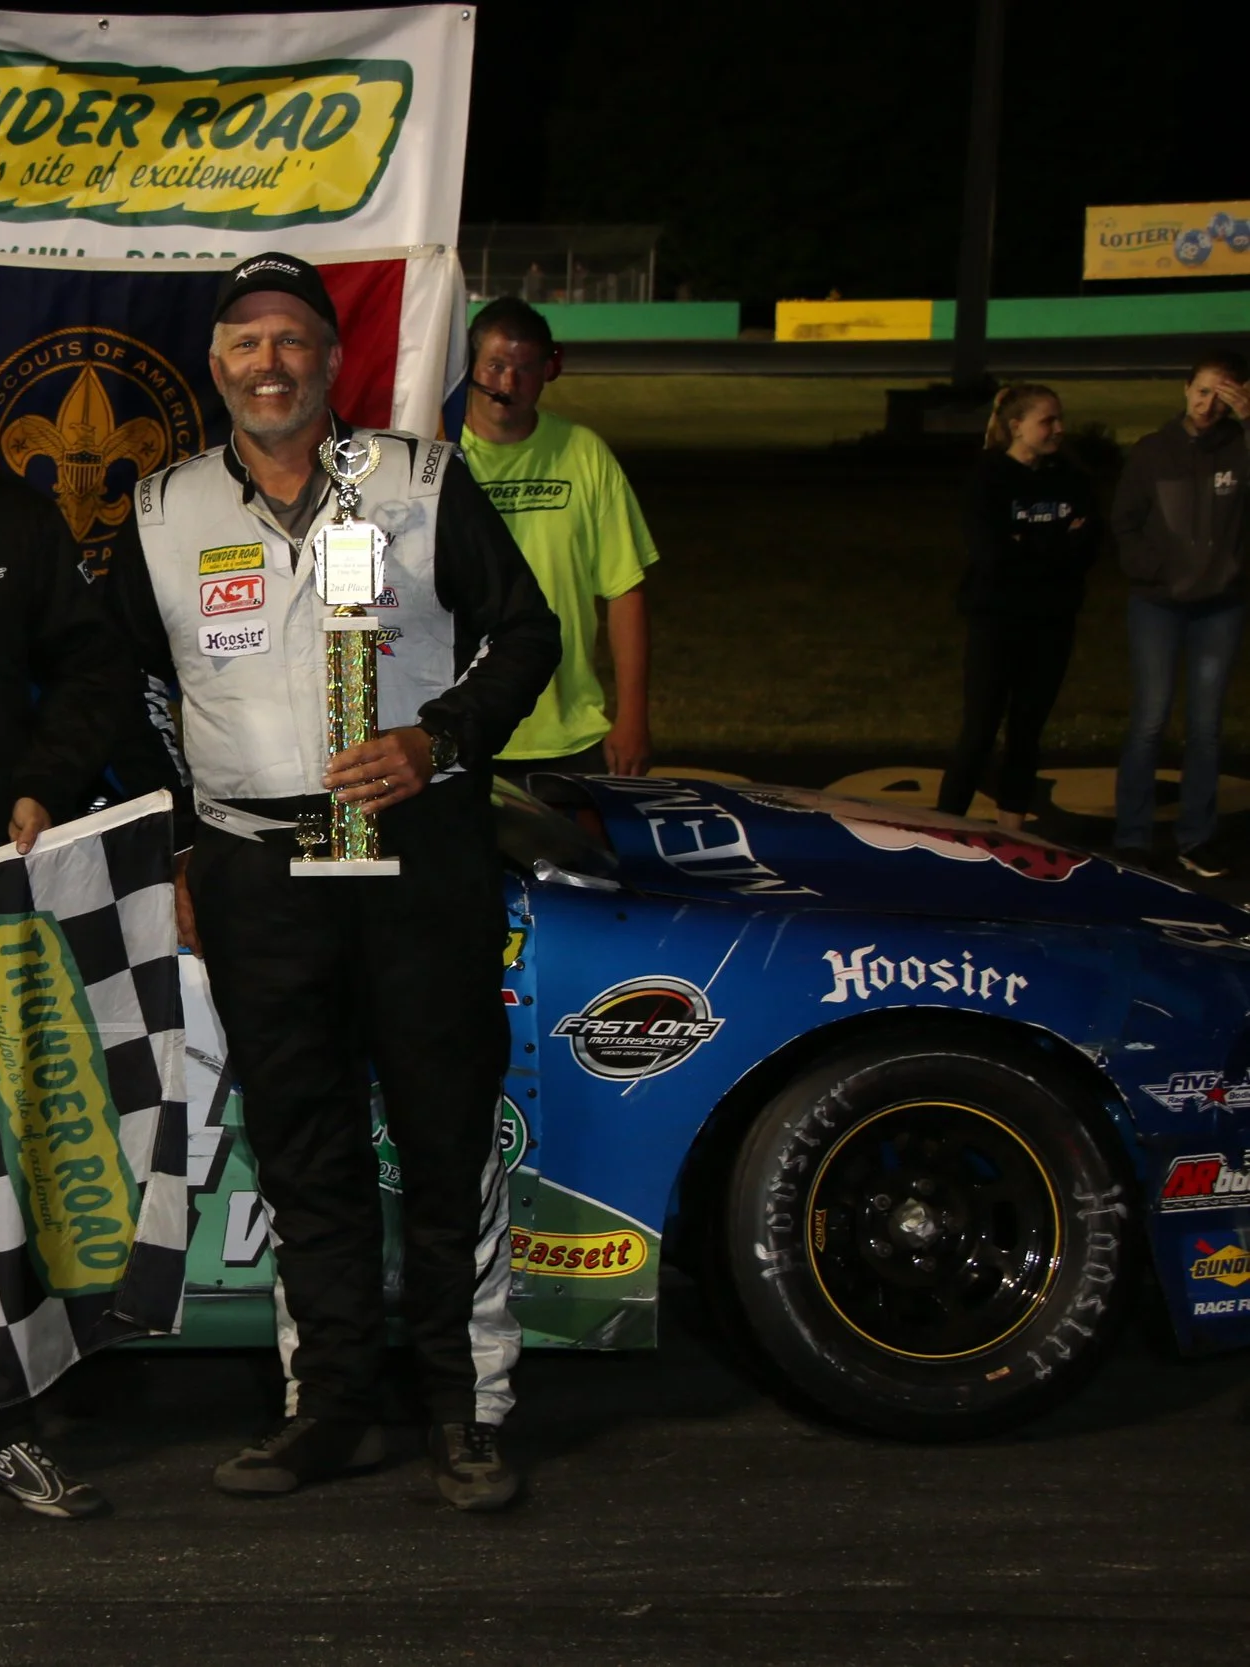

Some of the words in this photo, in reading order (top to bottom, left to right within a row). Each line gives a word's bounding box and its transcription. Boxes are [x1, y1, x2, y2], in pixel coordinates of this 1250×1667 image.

[161, 91, 360, 153] ROAD
[20, 154, 74, 189] site
[84, 160, 114, 193] of
[1100, 228, 1179, 248] LOTTERY
[93, 341, 127, 360] OF
[132, 359, 191, 463] AMERICA
[524, 484, 563, 497] ROAD
[202, 550, 238, 565] THUNDER
[239, 546, 260, 559] ROAD
[206, 579, 260, 606] ACT
[347, 582, 369, 593] Place
[205, 626, 265, 650] Hoosier
[820, 943, 1029, 1007] Hoosier
[557, 1017, 644, 1035] FAST
[648, 1019, 713, 1037] ONE
[587, 1036, 690, 1047] MOTORSPORTS
[1170, 1074, 1217, 1095] FIVE
[0, 928, 95, 1154] THUNDER
[54, 1154, 129, 1270] ROAD
[510, 1233, 632, 1270] Bassett
[1194, 1258, 1250, 1277] SUNO
[1193, 1299, 1236, 1316] RACE
